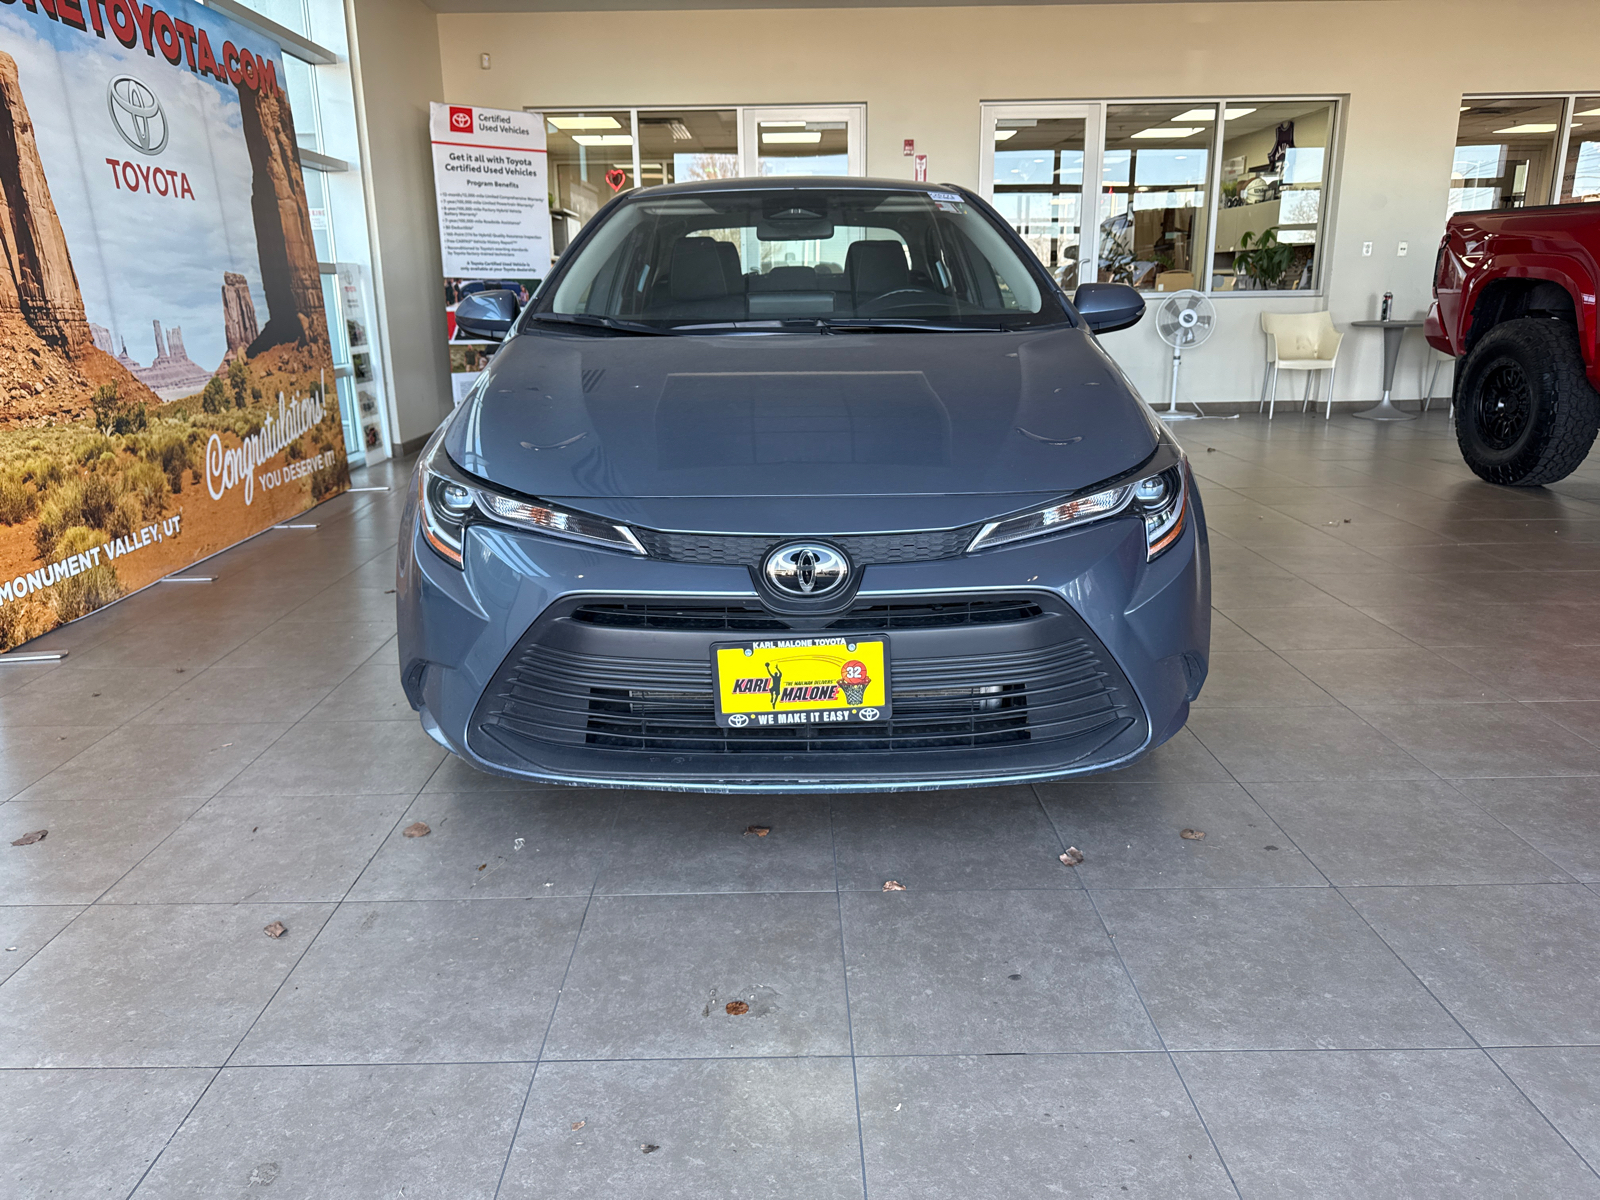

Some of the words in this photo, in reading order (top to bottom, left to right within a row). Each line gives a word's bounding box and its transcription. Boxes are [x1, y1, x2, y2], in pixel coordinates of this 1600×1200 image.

[0, 0, 280, 98] ETOYOTA.COM
[478, 114, 511, 124] Certified
[500, 126, 530, 135] Vehicles
[474, 154, 485, 162] all
[487, 156, 505, 164] with
[506, 157, 532, 167] Toyota
[445, 164, 482, 173] Certified
[484, 166, 504, 174] Used
[505, 168, 537, 177] Vehicles
[105, 158, 195, 200] TOYOTA
[206, 368, 327, 505] Congratulations!
[259, 472, 282, 492] YOU
[283, 457, 323, 484] DESERVE
[324, 450, 336, 467] IT!
[0, 546, 101, 607] MONUMENT
[103, 522, 164, 562] VALLEY,
[163, 515, 181, 537] UT
[752, 641, 774, 649] KARL
[778, 639, 812, 648] MALONE
[814, 637, 847, 646] TOYOTA
[846, 666, 862, 679] 32
[732, 678, 771, 694] KARL
[780, 686, 840, 702] MALONE
[758, 714, 775, 724] WE
[778, 712, 806, 723] MAKE
[811, 712, 820, 722] IT
[824, 711, 850, 721] EASY
